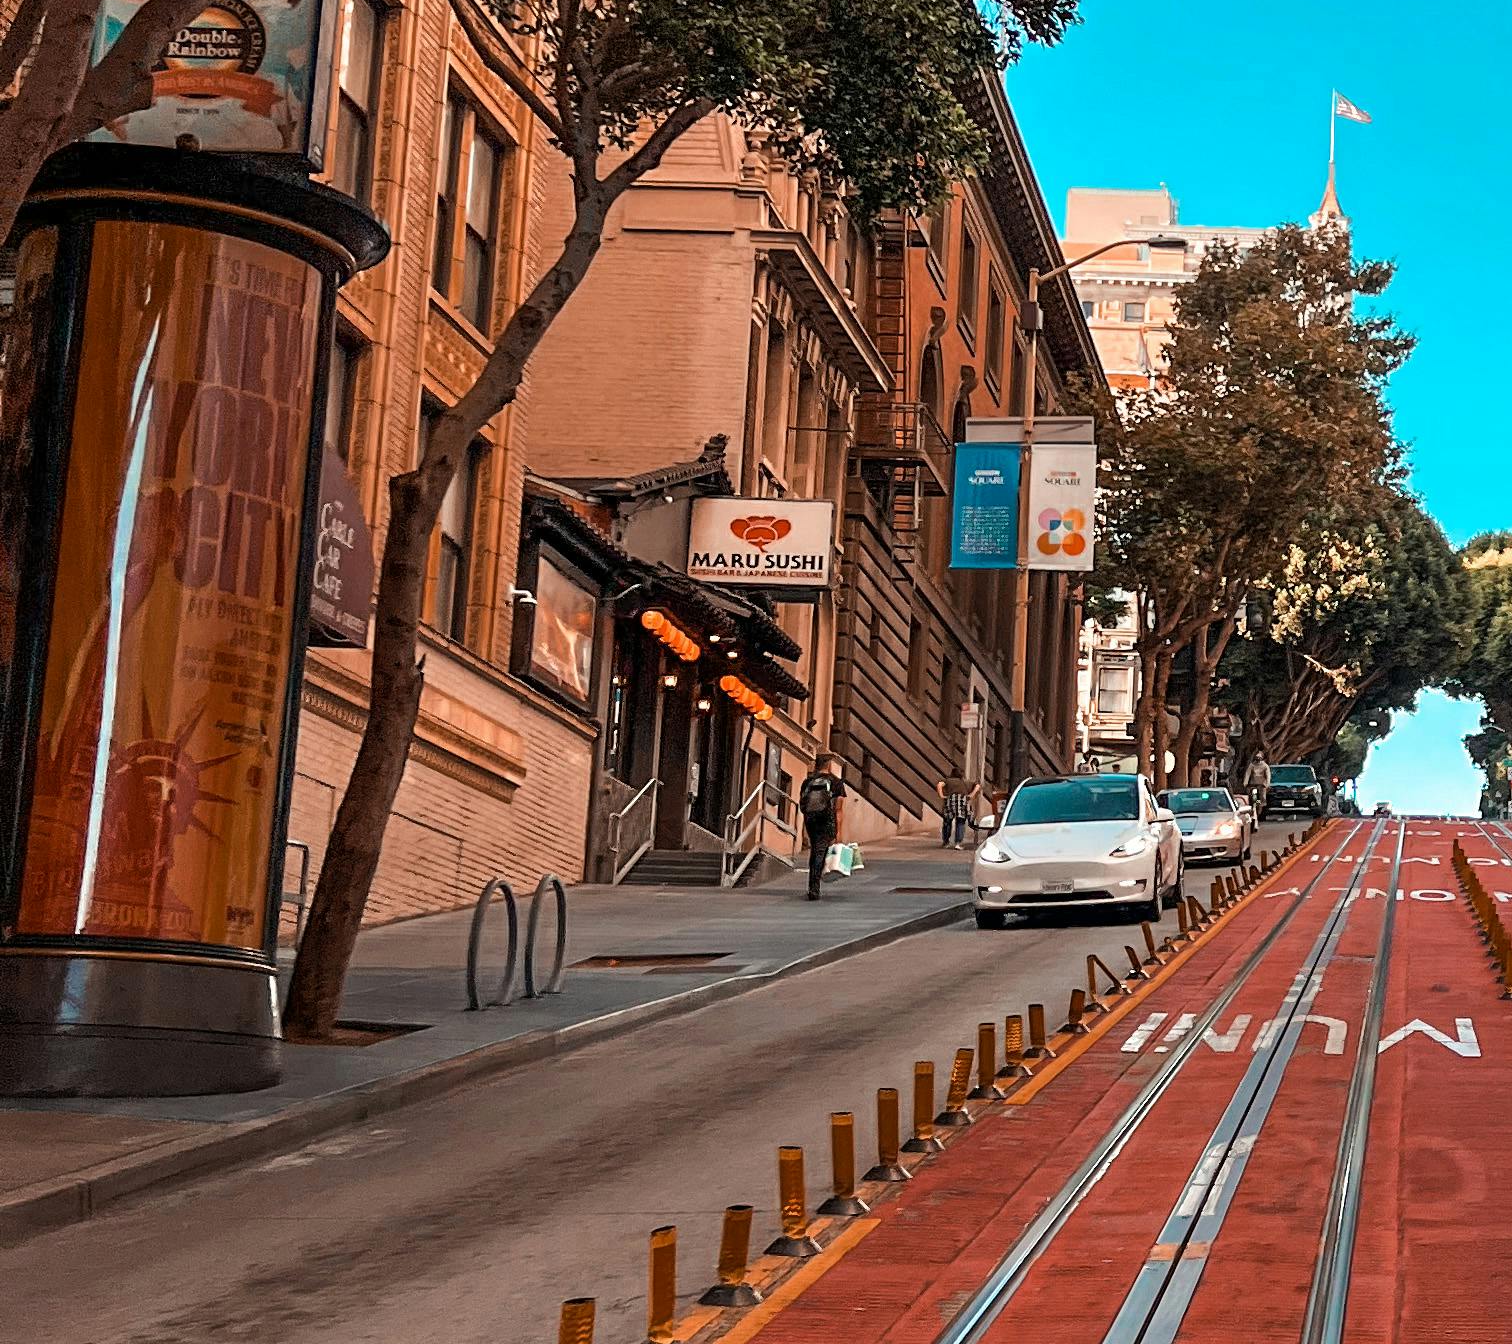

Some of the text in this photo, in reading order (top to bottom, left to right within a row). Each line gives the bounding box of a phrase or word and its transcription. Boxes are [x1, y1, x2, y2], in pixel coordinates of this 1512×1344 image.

[175, 29, 238, 43] Double
[168, 42, 241, 56] Rainbow
[691, 552, 823, 570] MARU SUSHI
